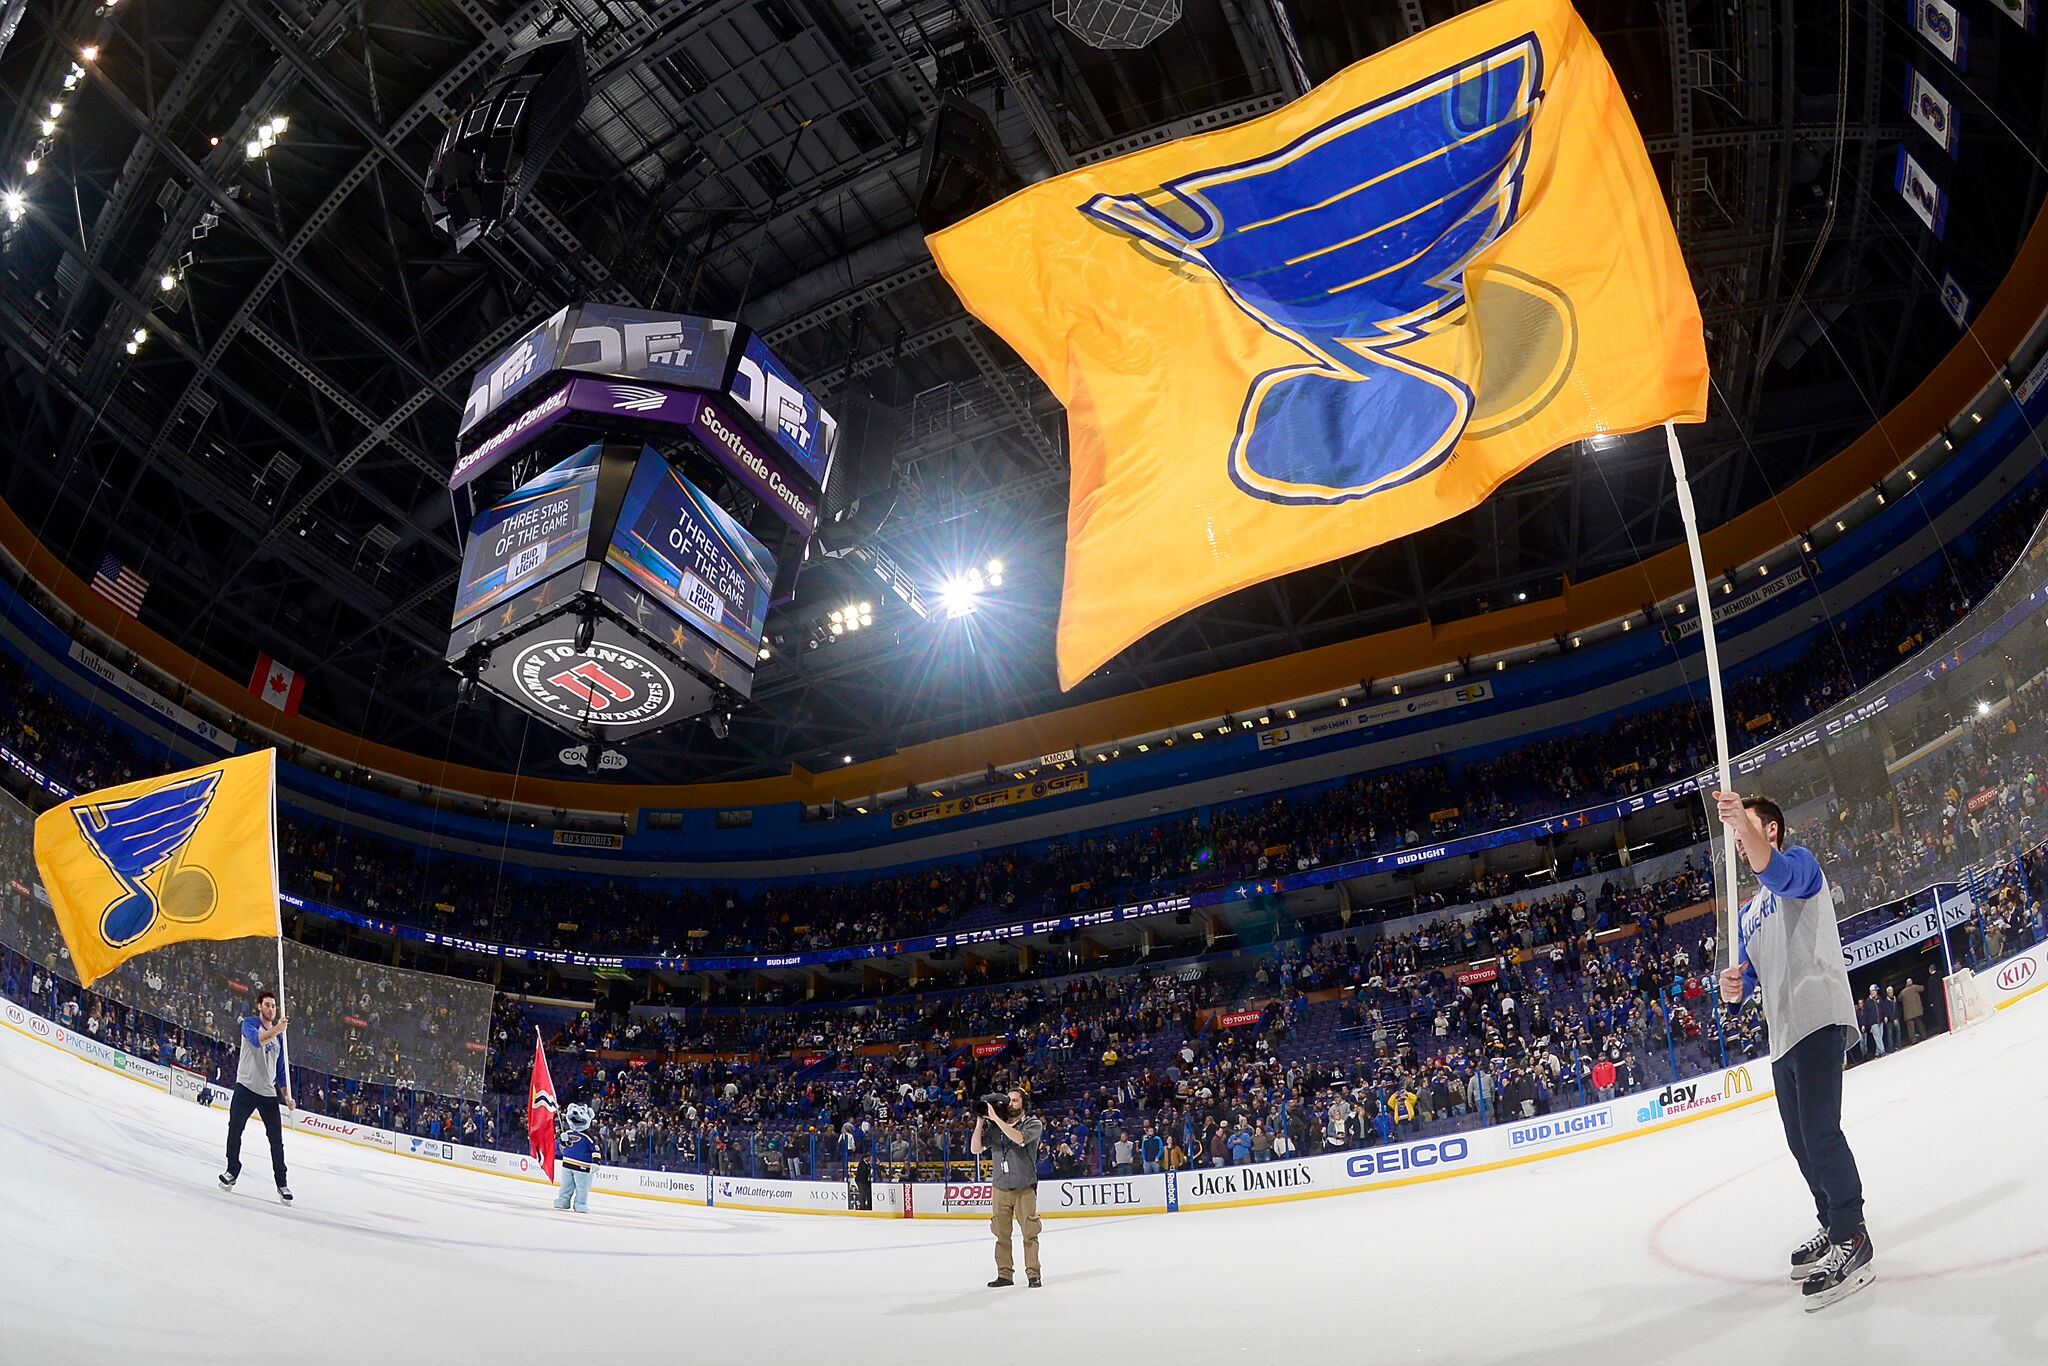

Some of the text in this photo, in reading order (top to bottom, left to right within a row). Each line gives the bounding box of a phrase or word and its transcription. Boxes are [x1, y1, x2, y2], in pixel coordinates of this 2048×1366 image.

[1920, 93, 1946, 132] 3
[1912, 177, 1935, 215] 2
[455, 389, 566, 476] Scottrade Center
[700, 406, 769, 480] Scottrade
[769, 471, 811, 520] Center
[501, 498, 570, 535] THREE STARS
[494, 512, 569, 558] OF THE GAME
[678, 507, 746, 592] THREE STARS
[515, 556, 540, 577] LIGHT
[519, 547, 539, 564] BUD
[669, 528, 745, 609] OF THE GAME
[688, 591, 717, 618] LIGHT
[695, 583, 715, 605] BUD
[1681, 622, 1698, 634] DAN
[1722, 593, 1761, 616] MEMORIAL
[1762, 579, 1785, 597] PRESS
[1786, 570, 1802, 585] BOX
[76, 648, 116, 683] Anthem
[524, 654, 560, 703] JIMMY
[577, 682, 664, 721] SANDWICHES
[1312, 719, 1350, 733] BUD LIGHT
[563, 750, 624, 766] CONGIX
[1043, 751, 1068, 764] KMOX
[1629, 797, 1645, 813] 3
[1738, 753, 1768, 775] OF
[1774, 730, 1820, 757] THE
[1825, 695, 1890, 737] GAME
[563, 833, 612, 847] BO'S BUDDIES
[1397, 847, 1446, 865] BUD LIGHT
[935, 896, 1191, 948] 3 STARS OF THE GAME
[1842, 903, 1967, 967] STERLING BNK
[425, 932, 624, 969] 3 STARS OF THE GAME
[766, 956, 801, 966] BUD LIGHT
[1469, 970, 1496, 981] TOYOTA
[2002, 962, 2031, 984] KIA
[7, 1008, 23, 1022] KIA
[31, 1019, 48, 1034] KIA
[1233, 1013, 1260, 1023] TOYOTA
[1636, 1084, 1698, 1123] all day
[1666, 1092, 1723, 1116] BREAKFAST
[300, 1115, 359, 1136] Schnucks
[1512, 1110, 1608, 1146] BUD LIGHT
[471, 1150, 498, 1164] Scottrade
[1346, 1138, 1468, 1178] GEICO
[735, 1184, 793, 1199] MOLottery.com
[1060, 1181, 1141, 1207] STIFEL
[1167, 1172, 1176, 1204] Reebok
[1191, 1163, 1312, 1197] JACK DANIEL'S
[904, 1183, 912, 1211] Reebok
